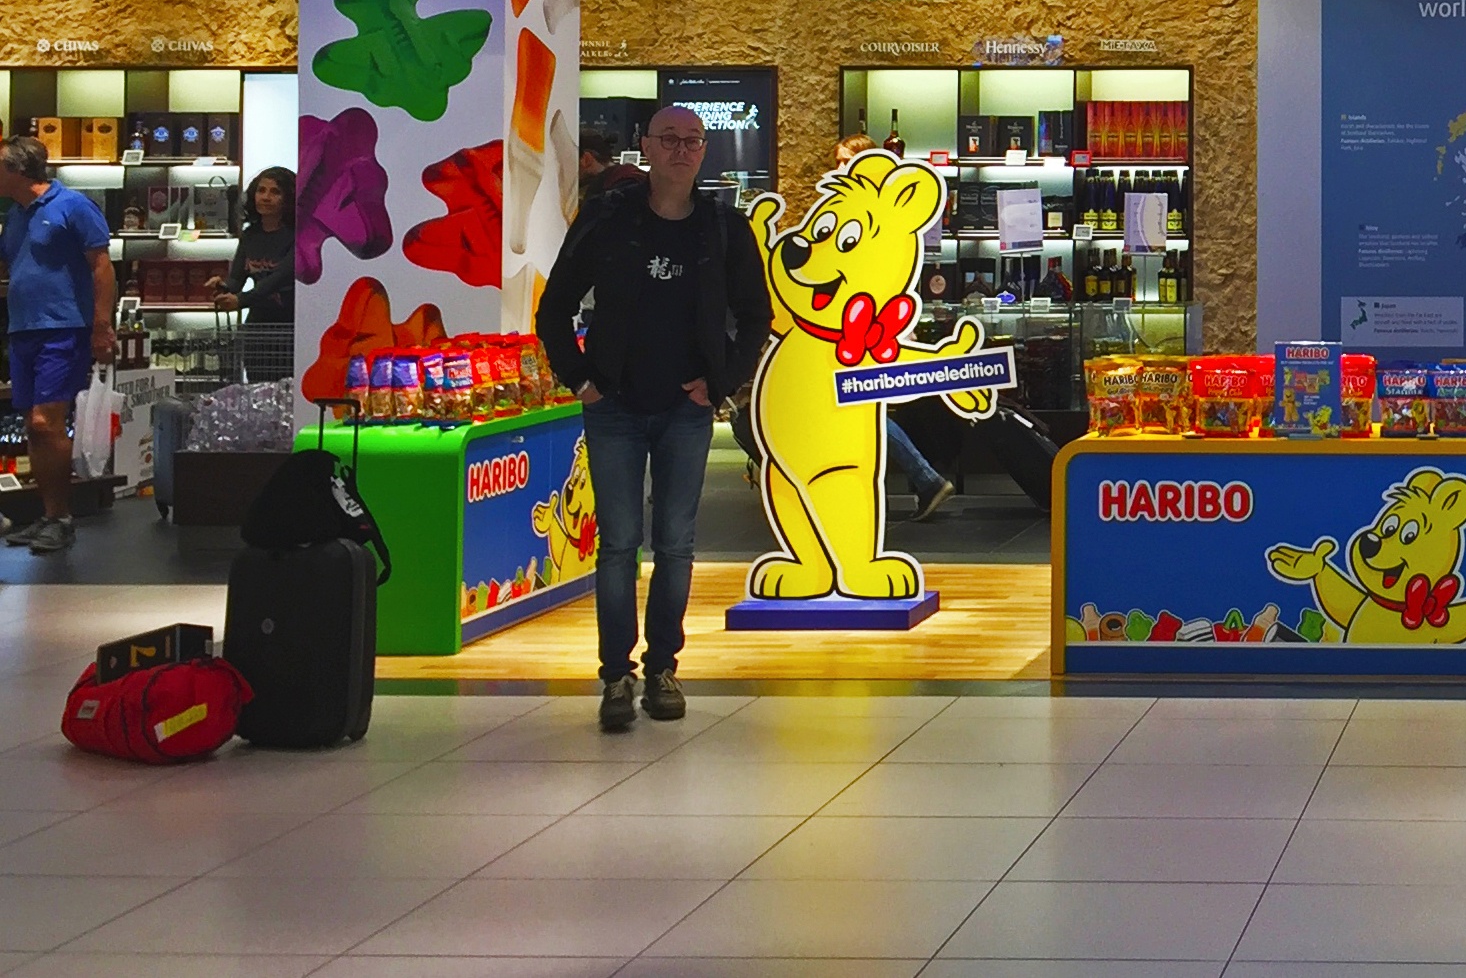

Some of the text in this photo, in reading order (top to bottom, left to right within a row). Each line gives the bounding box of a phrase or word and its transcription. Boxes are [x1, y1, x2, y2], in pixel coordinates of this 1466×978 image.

[53, 40, 99, 52] CHIVAS
[168, 40, 214, 52] CHIVAS
[859, 41, 940, 56] COURVOISIER
[985, 40, 1048, 55] Hennessy
[1101, 40, 1156, 51] METAXA
[579, 50, 609, 58] ALKER
[1285, 347, 1330, 359] HARIBO
[841, 362, 1005, 394] #haribotraveledition
[1141, 372, 1178, 383] HARIBO
[1341, 375, 1368, 387] RIBO
[467, 450, 530, 503] HARIBO
[1098, 479, 1254, 522] HARIBO
